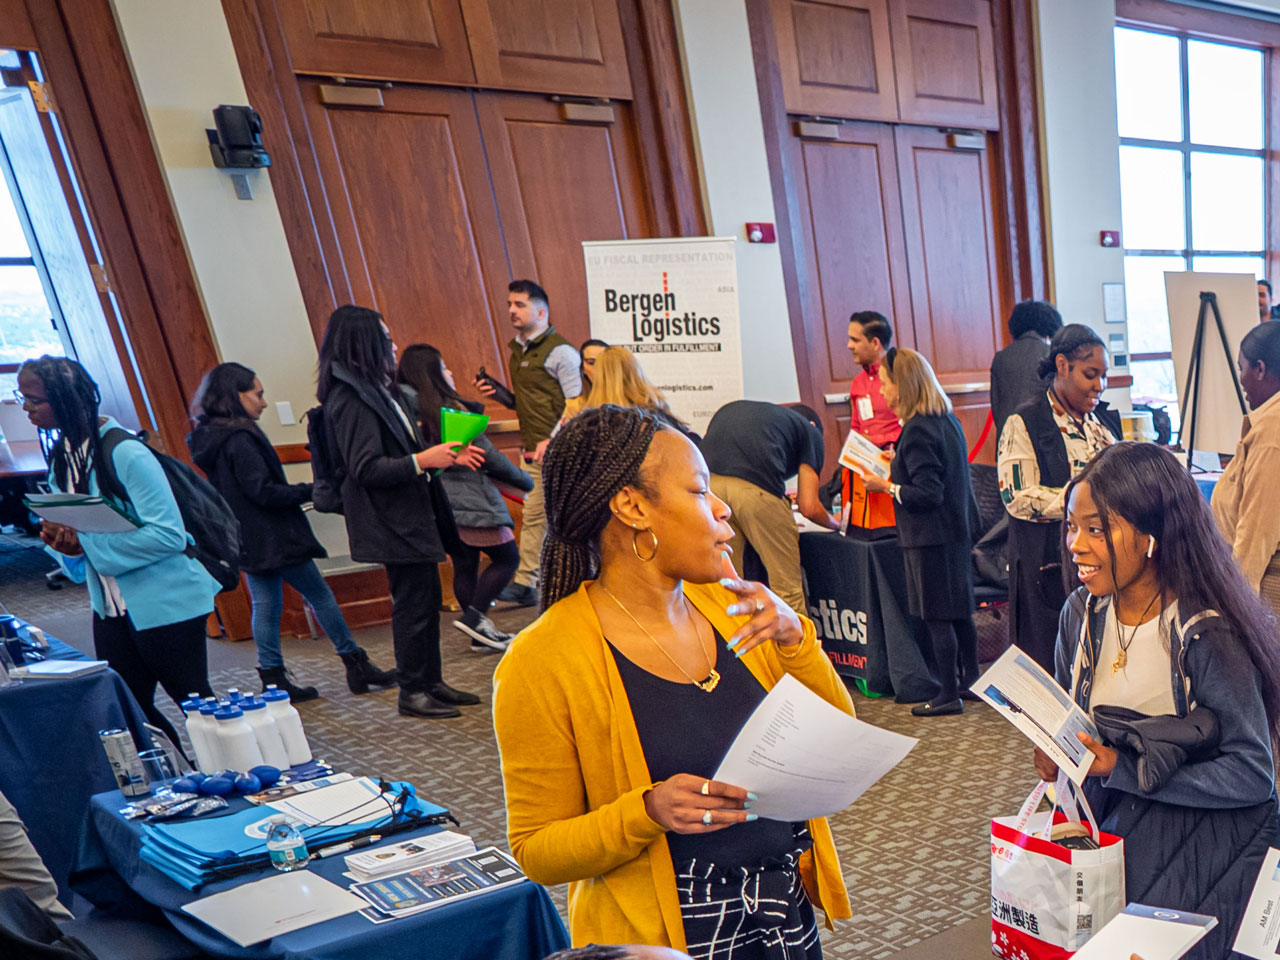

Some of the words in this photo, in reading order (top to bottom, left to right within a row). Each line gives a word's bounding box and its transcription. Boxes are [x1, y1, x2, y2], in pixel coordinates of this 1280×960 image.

[604, 254, 639, 265] FISCAL
[641, 252, 734, 264] REPRESENTATION
[604, 288, 677, 317] Bergen
[632, 312, 721, 342] Logistics
[638, 344, 663, 353] ORDER
[664, 344, 671, 352] IN
[672, 343, 719, 352] FULFILLMENT
[809, 599, 868, 645] stics
[828, 651, 868, 670] FILLMENT
[1259, 916, 1269, 929] AM
[1264, 899, 1275, 917] Best
